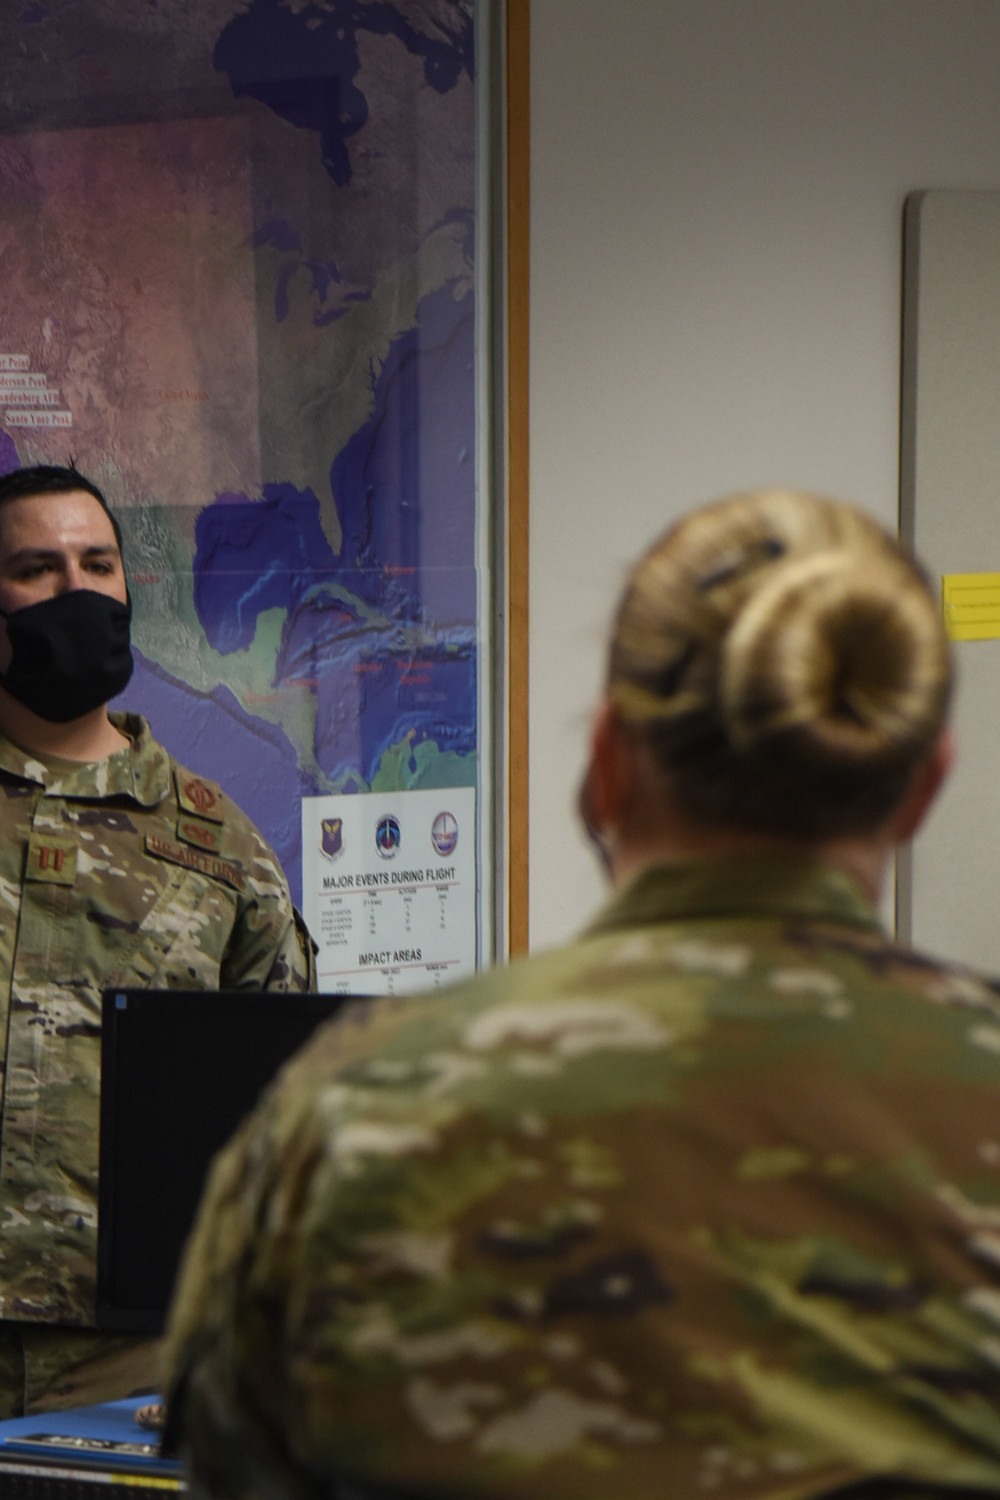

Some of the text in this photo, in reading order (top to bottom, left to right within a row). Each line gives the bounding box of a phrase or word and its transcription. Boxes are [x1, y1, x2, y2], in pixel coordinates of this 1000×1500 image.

[28, 376, 46, 386] Peak
[51, 414, 69, 424] Peak
[323, 867, 456, 889] MAJOR EVENTS DURING FLIGHT
[359, 949, 422, 966] IMPACT AREAS
